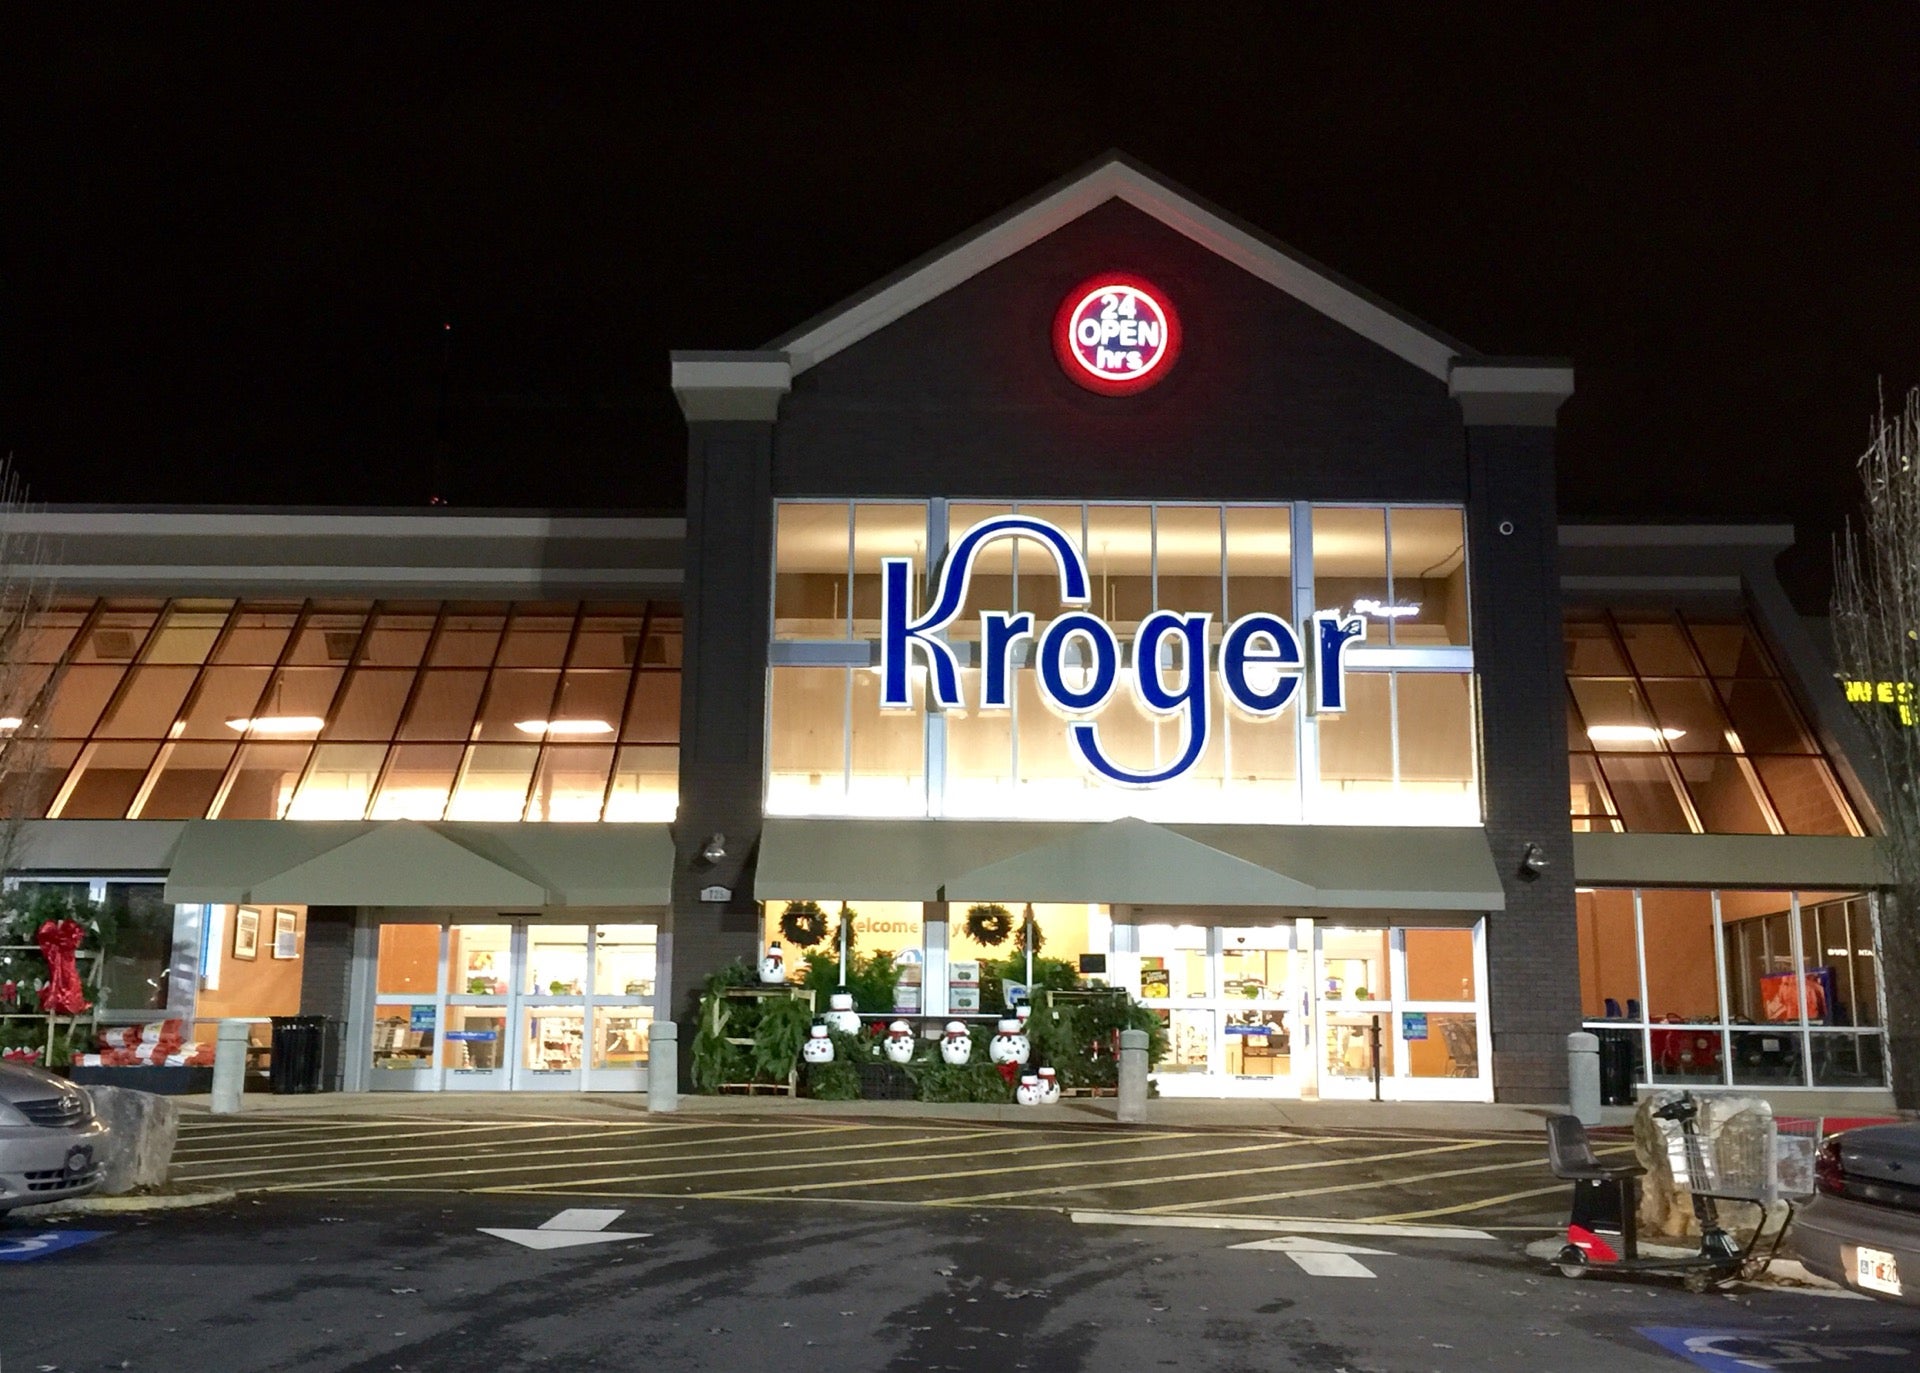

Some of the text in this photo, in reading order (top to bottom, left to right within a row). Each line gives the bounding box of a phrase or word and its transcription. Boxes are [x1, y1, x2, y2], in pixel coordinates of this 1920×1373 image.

[1100, 293, 1137, 320] 24
[1078, 318, 1159, 347] OPEN
[1096, 346, 1144, 370] hrs
[880, 514, 1367, 790] Kroger
[854, 917, 919, 933] elcome
